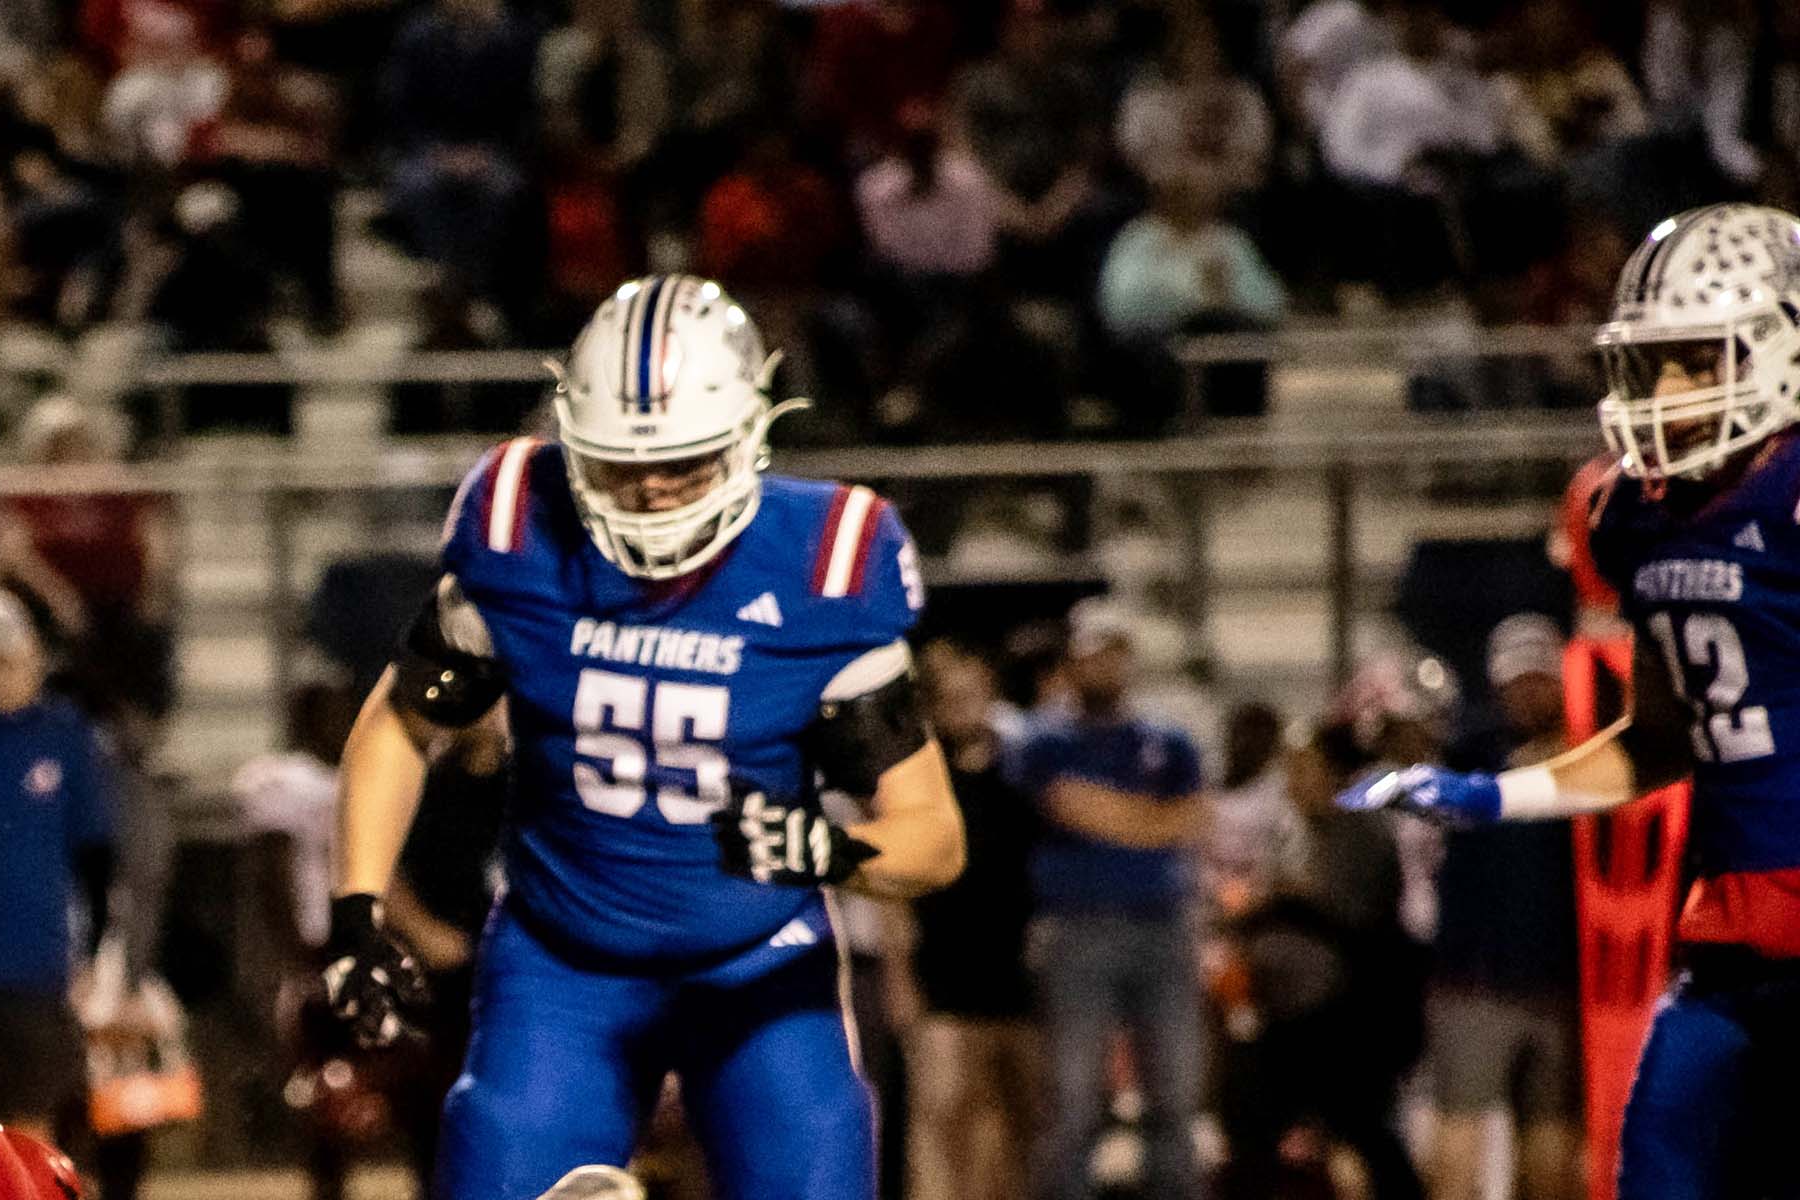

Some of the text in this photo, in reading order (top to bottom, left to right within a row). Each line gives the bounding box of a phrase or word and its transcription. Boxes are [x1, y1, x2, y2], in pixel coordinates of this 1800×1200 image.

[570, 616, 746, 676] PANTHERS
[1648, 611, 1777, 764] 12
[571, 667, 733, 825] 55
